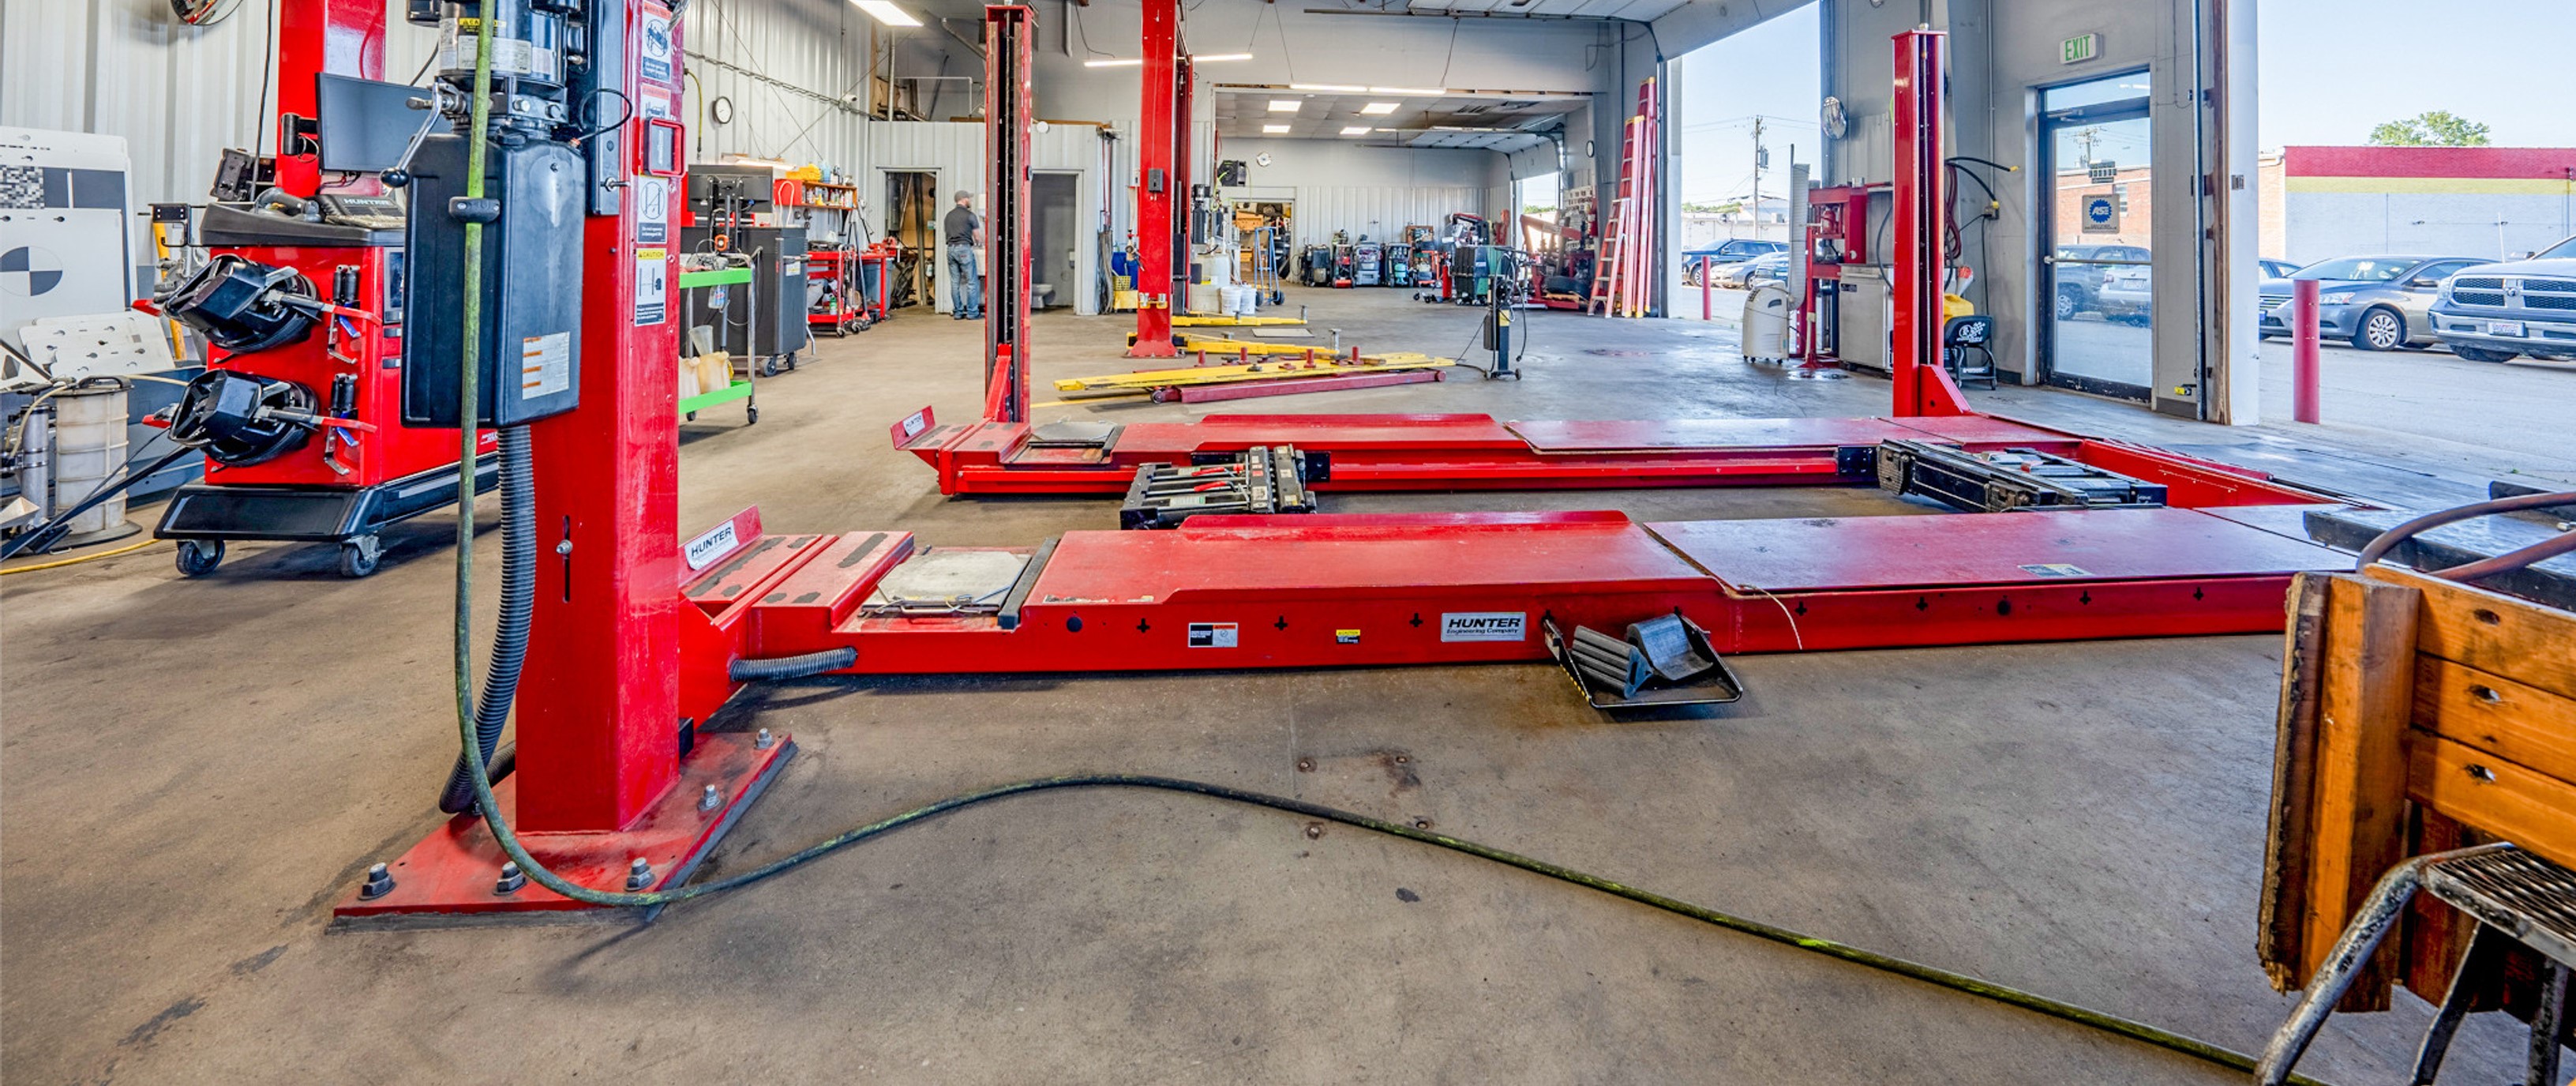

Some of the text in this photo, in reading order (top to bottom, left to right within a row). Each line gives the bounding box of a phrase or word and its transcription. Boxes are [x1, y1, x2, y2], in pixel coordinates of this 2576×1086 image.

[2065, 35, 2090, 61] EXIT
[2091, 206, 2110, 216] ASE
[692, 526, 732, 557] HUNTER
[1448, 618, 1521, 628] HUNTER
